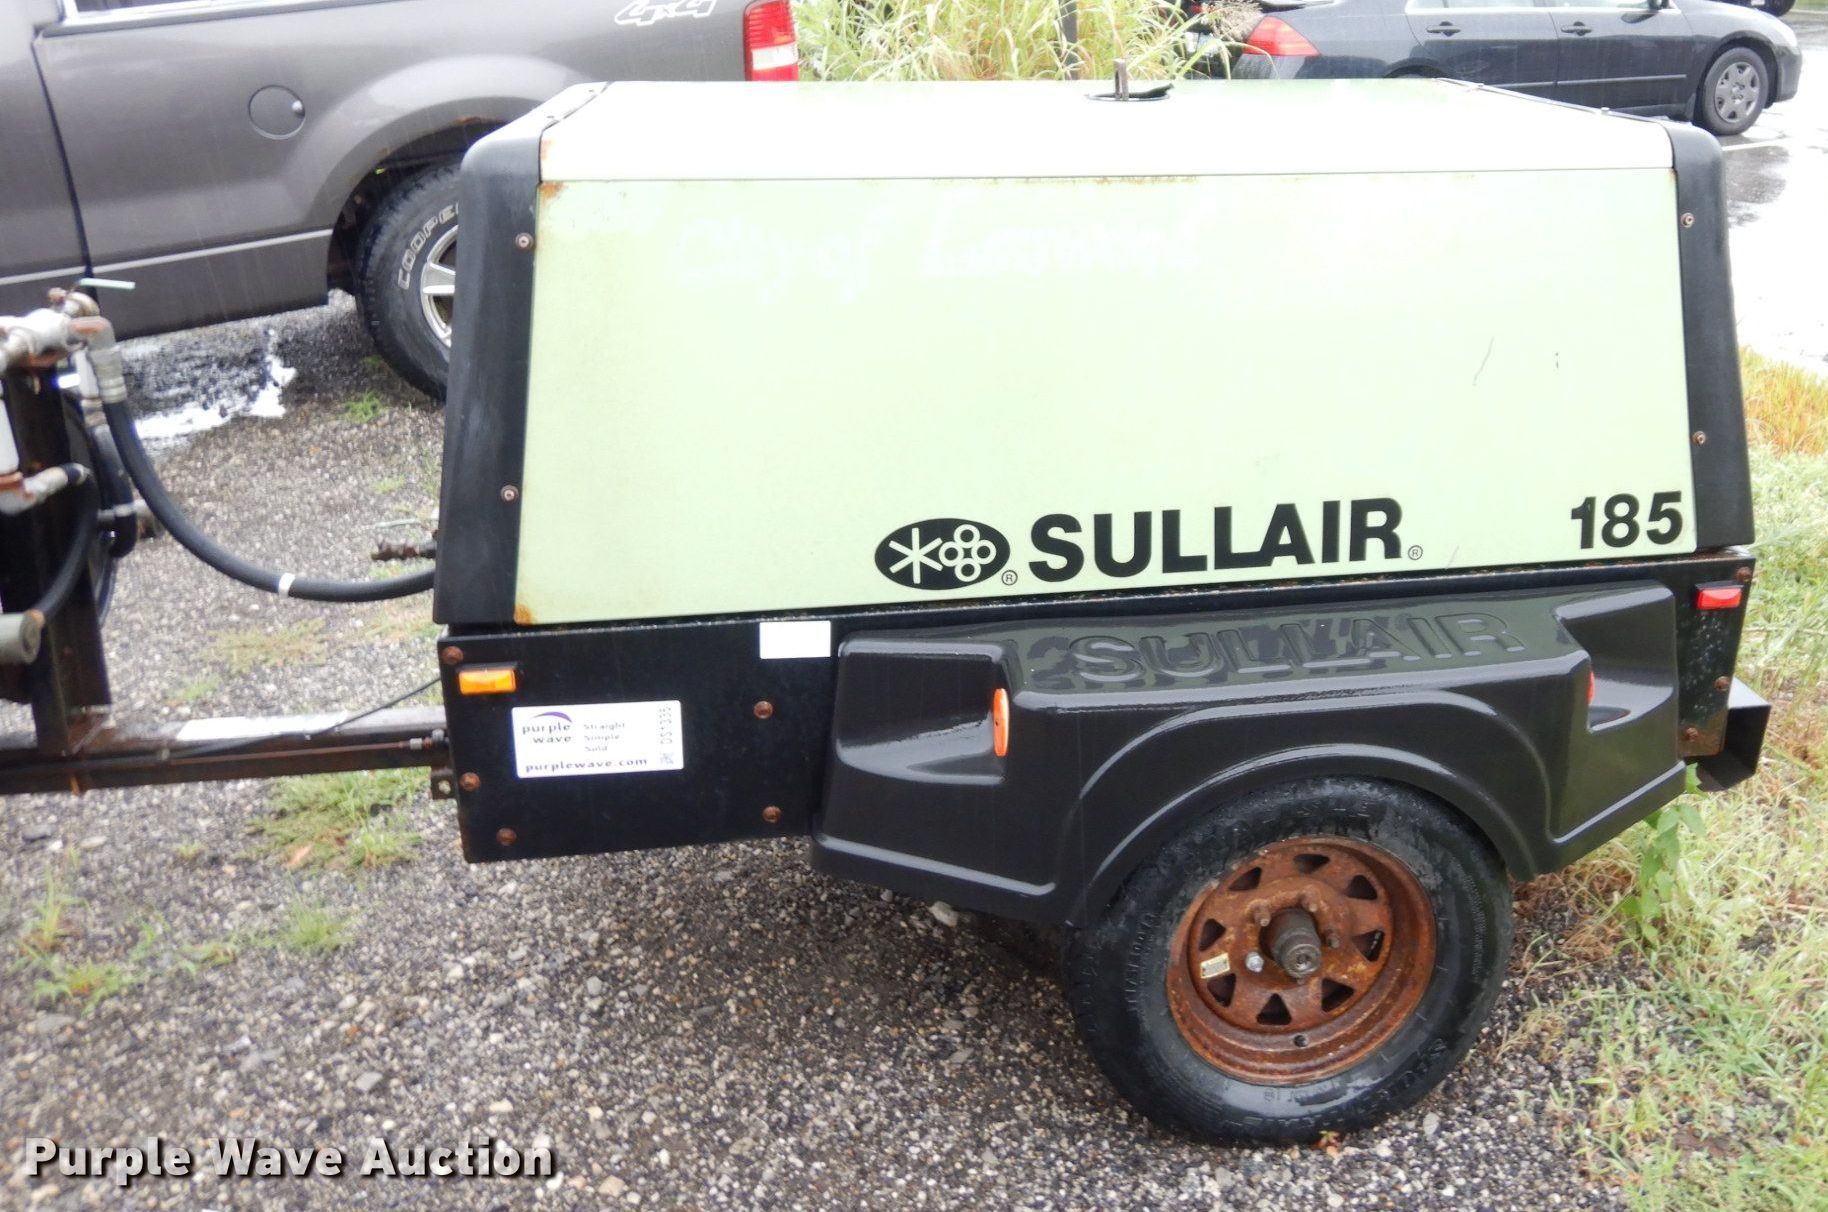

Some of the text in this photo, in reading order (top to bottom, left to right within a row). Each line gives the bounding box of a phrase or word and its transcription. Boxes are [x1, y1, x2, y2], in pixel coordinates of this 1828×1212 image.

[398, 202, 459, 290] COOPE
[1028, 497, 1403, 583] SULLAIR
[1570, 490, 1684, 550] 185
[1069, 612, 1526, 685] SULLAIR
[522, 722, 572, 735] purple
[533, 735, 572, 744] wave
[525, 758, 648, 773] purplewave.com
